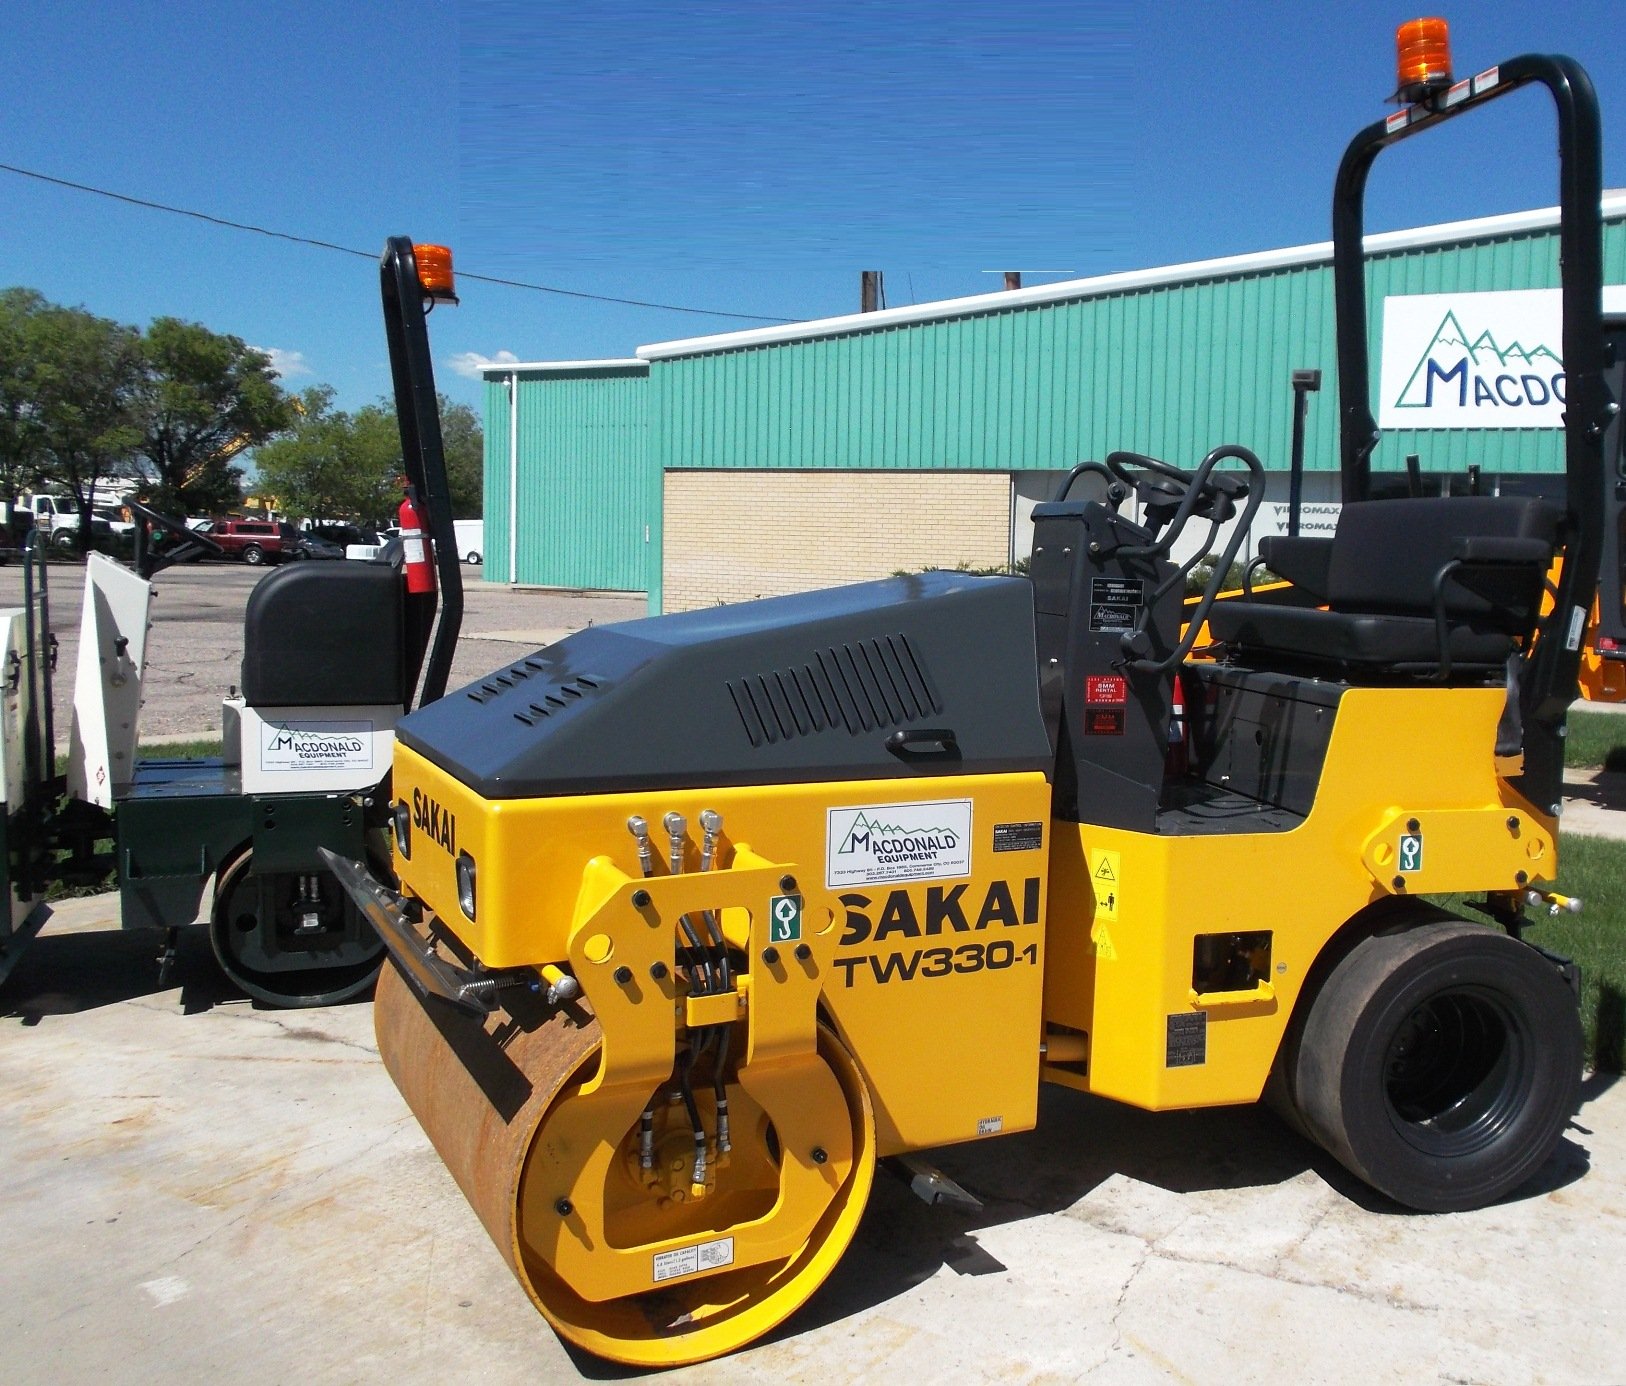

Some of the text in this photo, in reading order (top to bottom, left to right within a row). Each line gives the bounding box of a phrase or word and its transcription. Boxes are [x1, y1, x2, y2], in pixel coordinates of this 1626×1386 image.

[1425, 356, 1567, 408] MACDO
[1273, 505, 1340, 517] VIOMAX
[1276, 521, 1337, 533] VIROMA
[278, 736, 362, 753] MACDONALD
[413, 786, 456, 858] SAKAI
[851, 831, 957, 855] MACDONALD
[877, 851, 938, 864] EQUIPMENT
[838, 876, 1041, 946] SAKAI
[833, 939, 1038, 988] TW330-1
